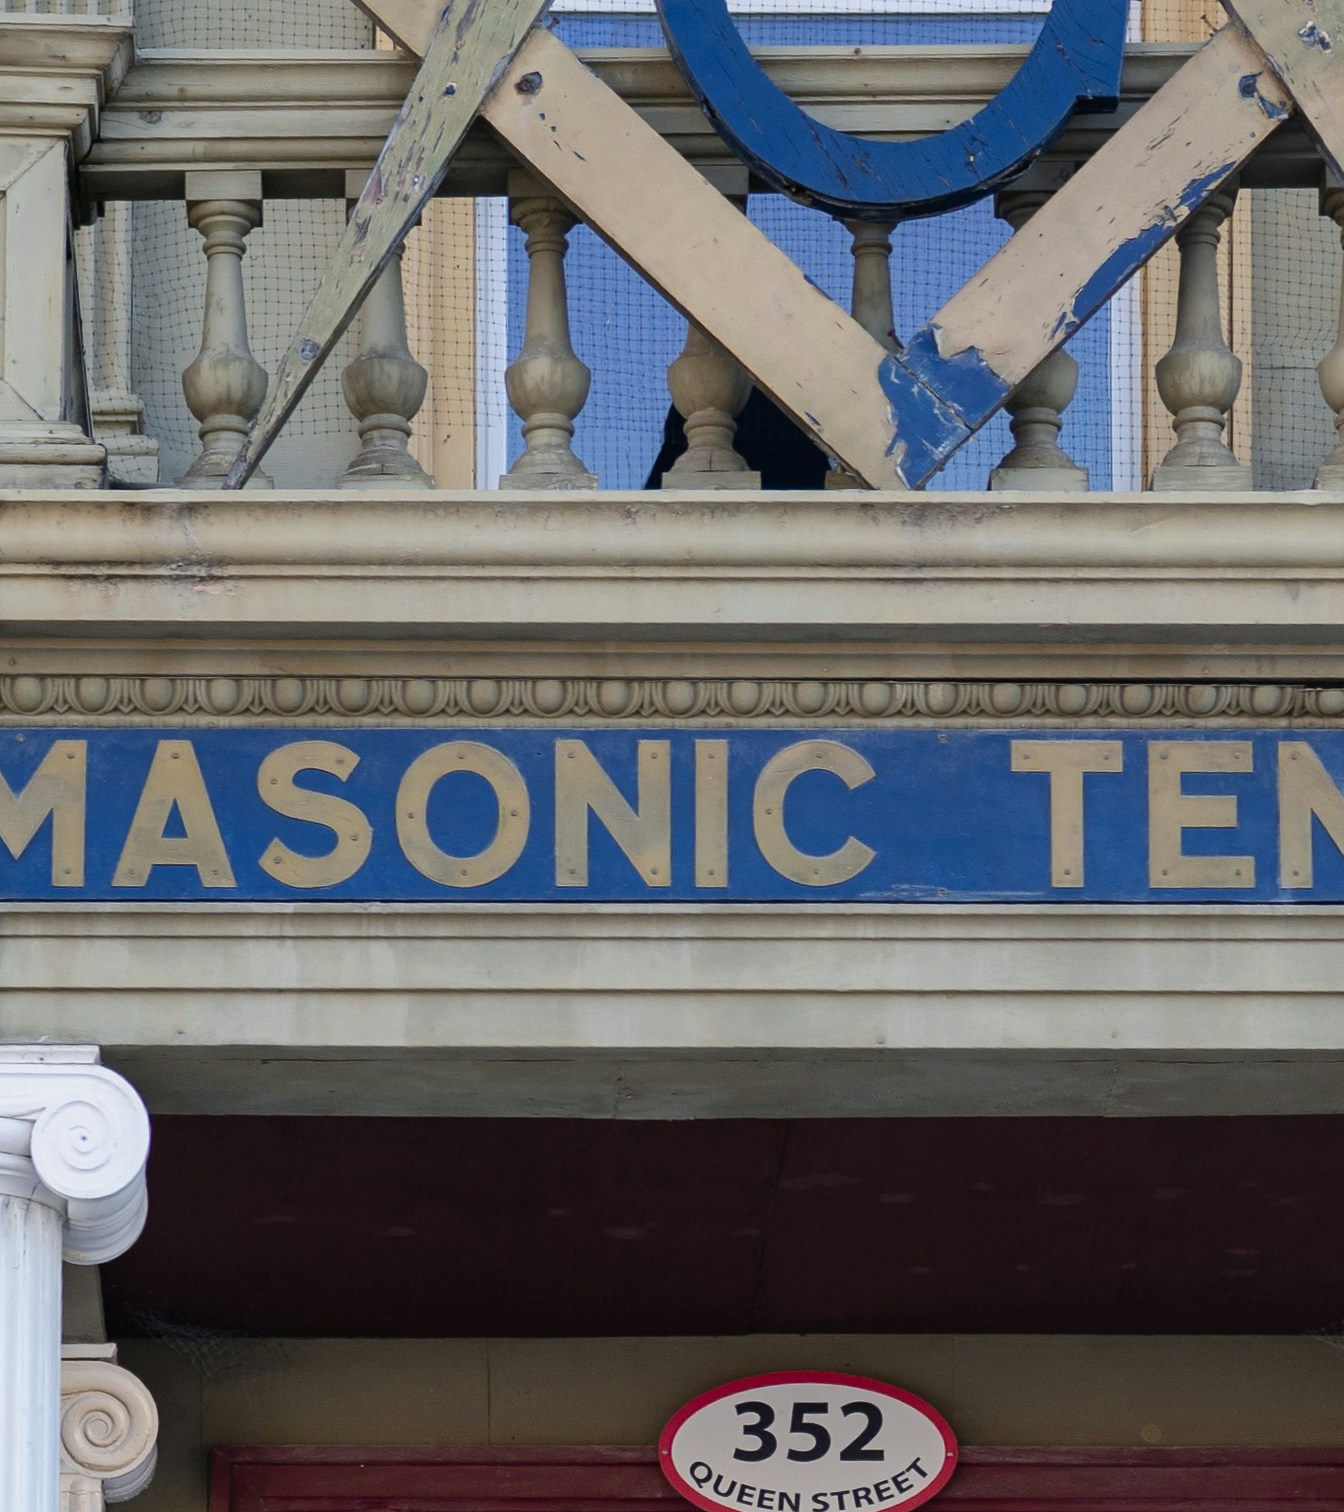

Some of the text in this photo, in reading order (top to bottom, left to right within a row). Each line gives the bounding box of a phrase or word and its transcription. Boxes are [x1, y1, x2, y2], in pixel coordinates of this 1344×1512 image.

[733, 1401, 885, 1462] 352
[688, 1456, 930, 1512] QUEEN STREET
